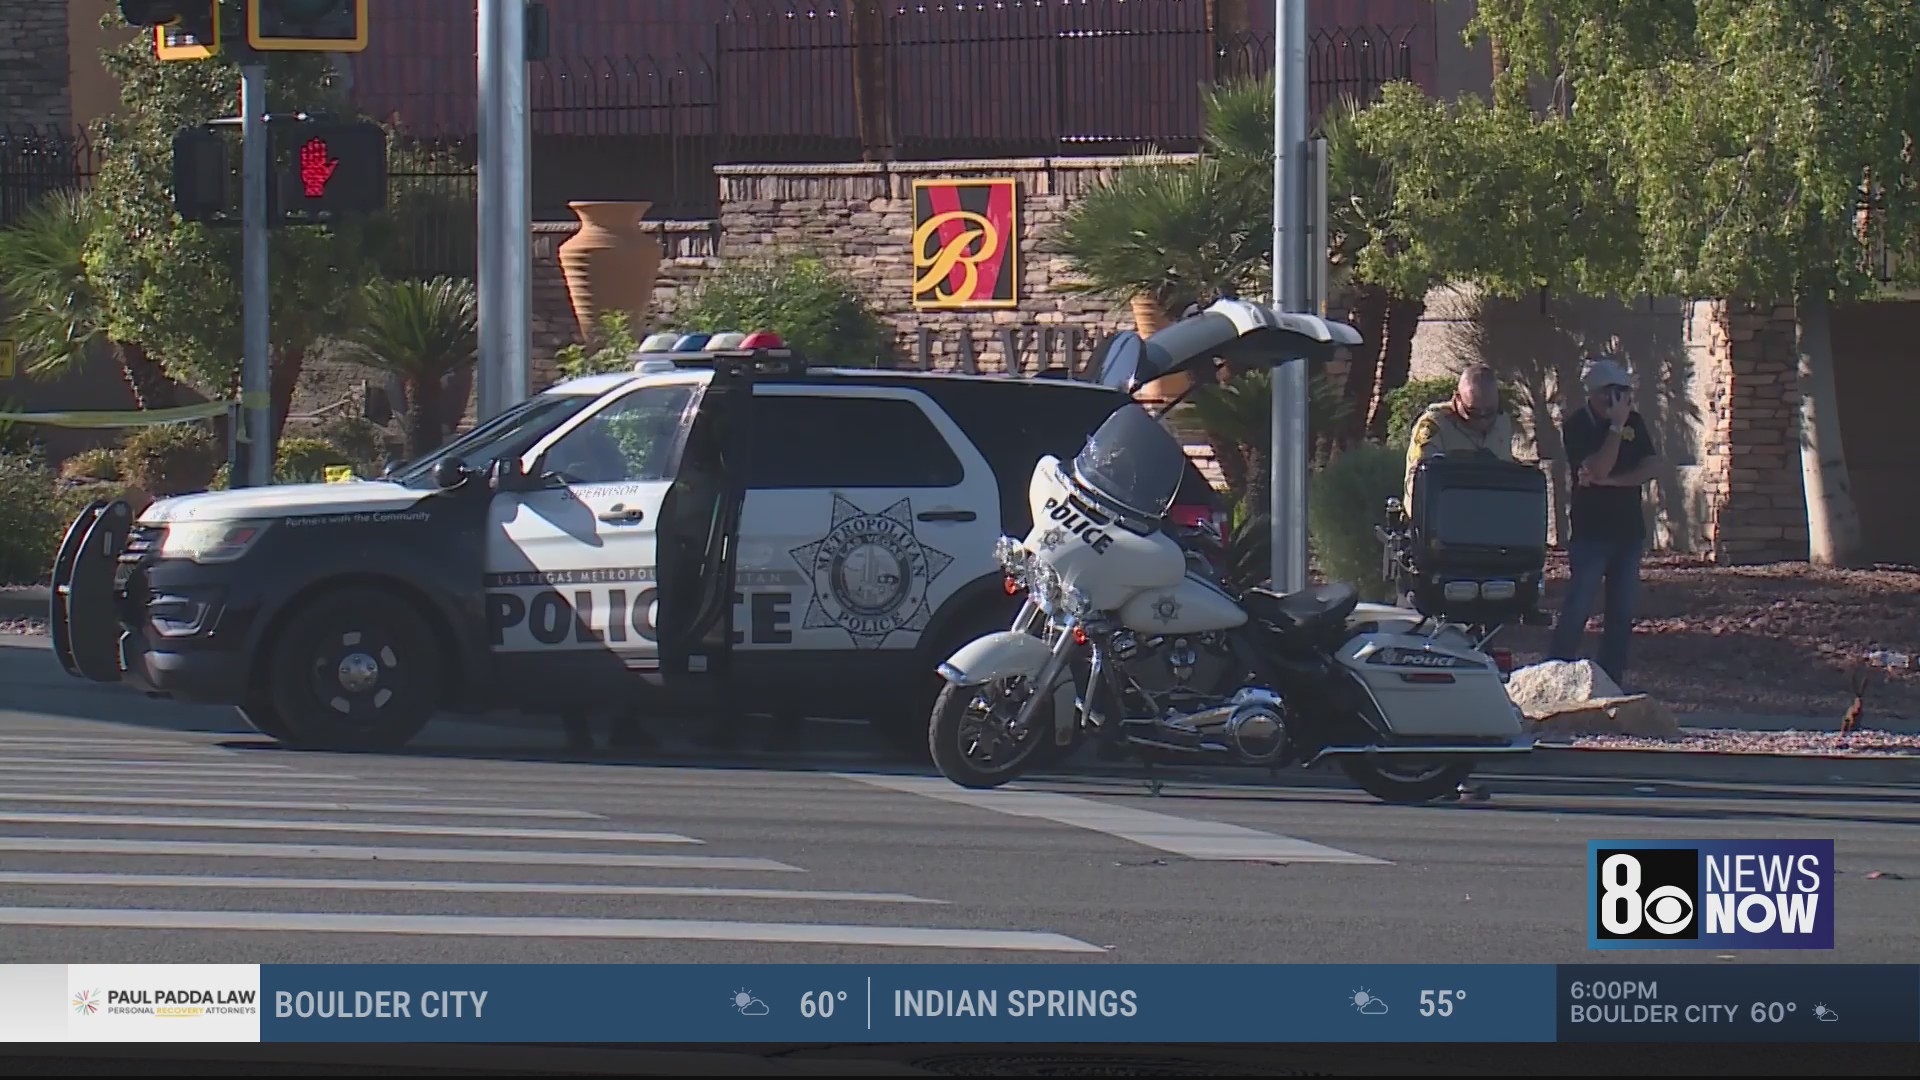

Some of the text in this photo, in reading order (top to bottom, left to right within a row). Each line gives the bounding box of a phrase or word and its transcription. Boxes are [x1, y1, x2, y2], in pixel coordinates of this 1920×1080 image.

[561, 485, 639, 500] SUPERVISOR
[285, 511, 431, 527] Partners with the Community
[1040, 497, 1115, 556] POLICE
[816, 520, 925, 578] METROPOLITAN
[499, 574, 521, 586] LAS
[528, 570, 574, 585] VEGAS
[837, 611, 904, 633] POLICE
[1402, 655, 1457, 667] POLICE
